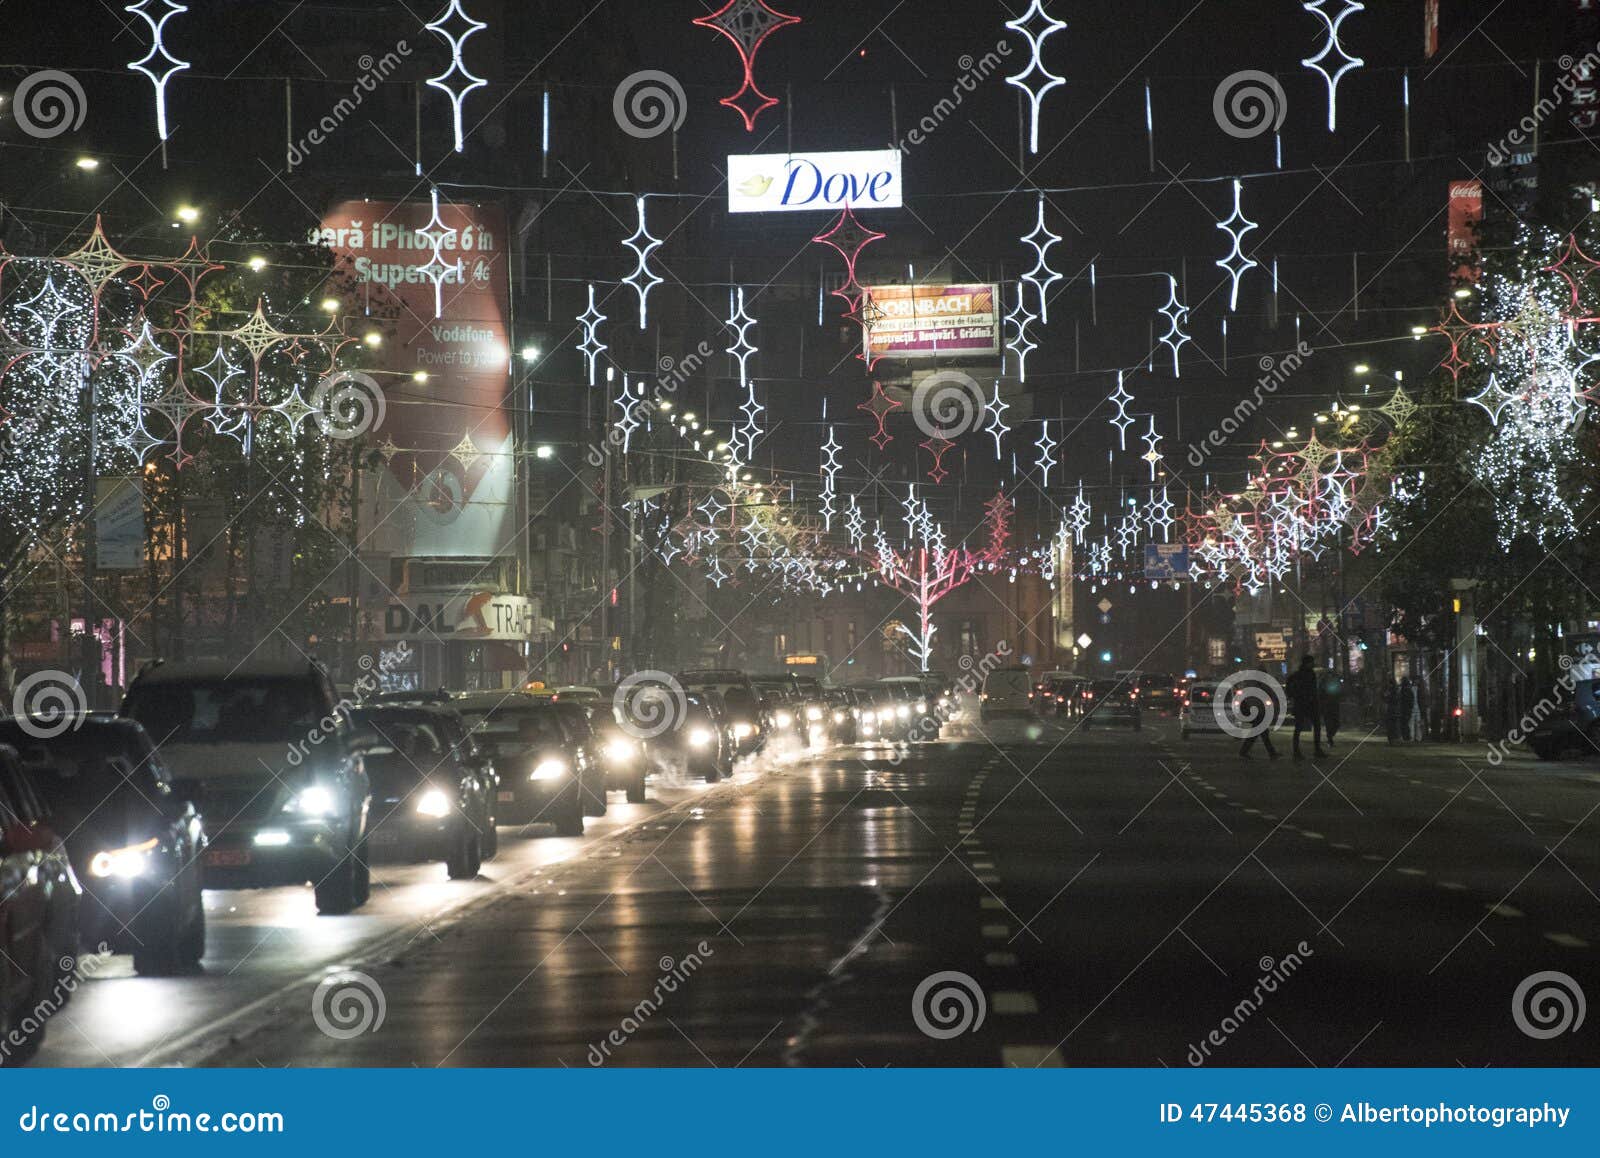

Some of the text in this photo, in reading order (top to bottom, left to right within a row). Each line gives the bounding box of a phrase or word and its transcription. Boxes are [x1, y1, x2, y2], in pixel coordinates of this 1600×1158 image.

[781, 159, 893, 206] Dove
[372, 222, 458, 250] iPhone
[461, 225, 473, 250] 6
[354, 256, 465, 289] Supernet
[432, 325, 494, 342] Vodafone
[417, 348, 457, 365] Power
[459, 349, 472, 365] to
[385, 603, 455, 633] DAL
